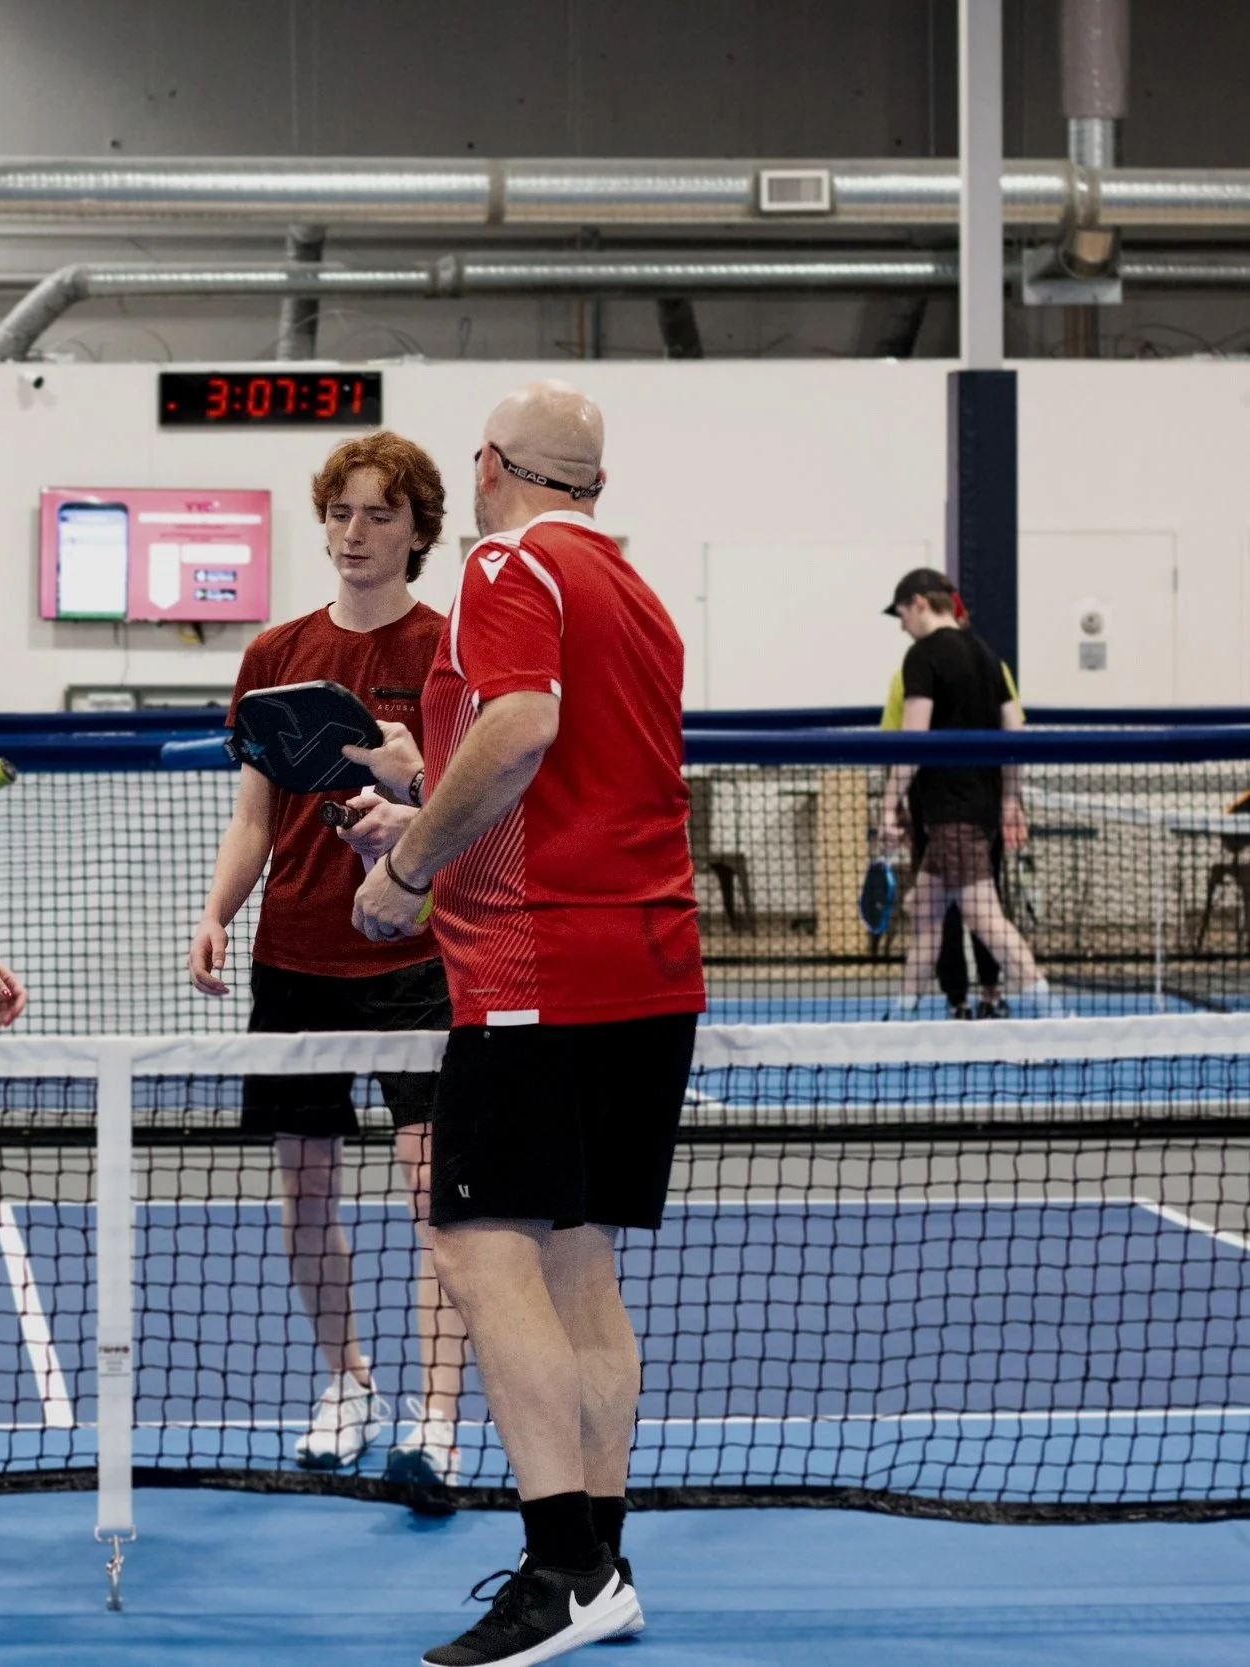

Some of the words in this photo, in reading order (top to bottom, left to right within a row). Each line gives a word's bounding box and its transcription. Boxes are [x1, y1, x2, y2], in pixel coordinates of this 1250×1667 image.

[205, 377, 363, 418] 3:07:31
[507, 463, 548, 485] HEAD
[377, 704, 415, 712] AE/USA
